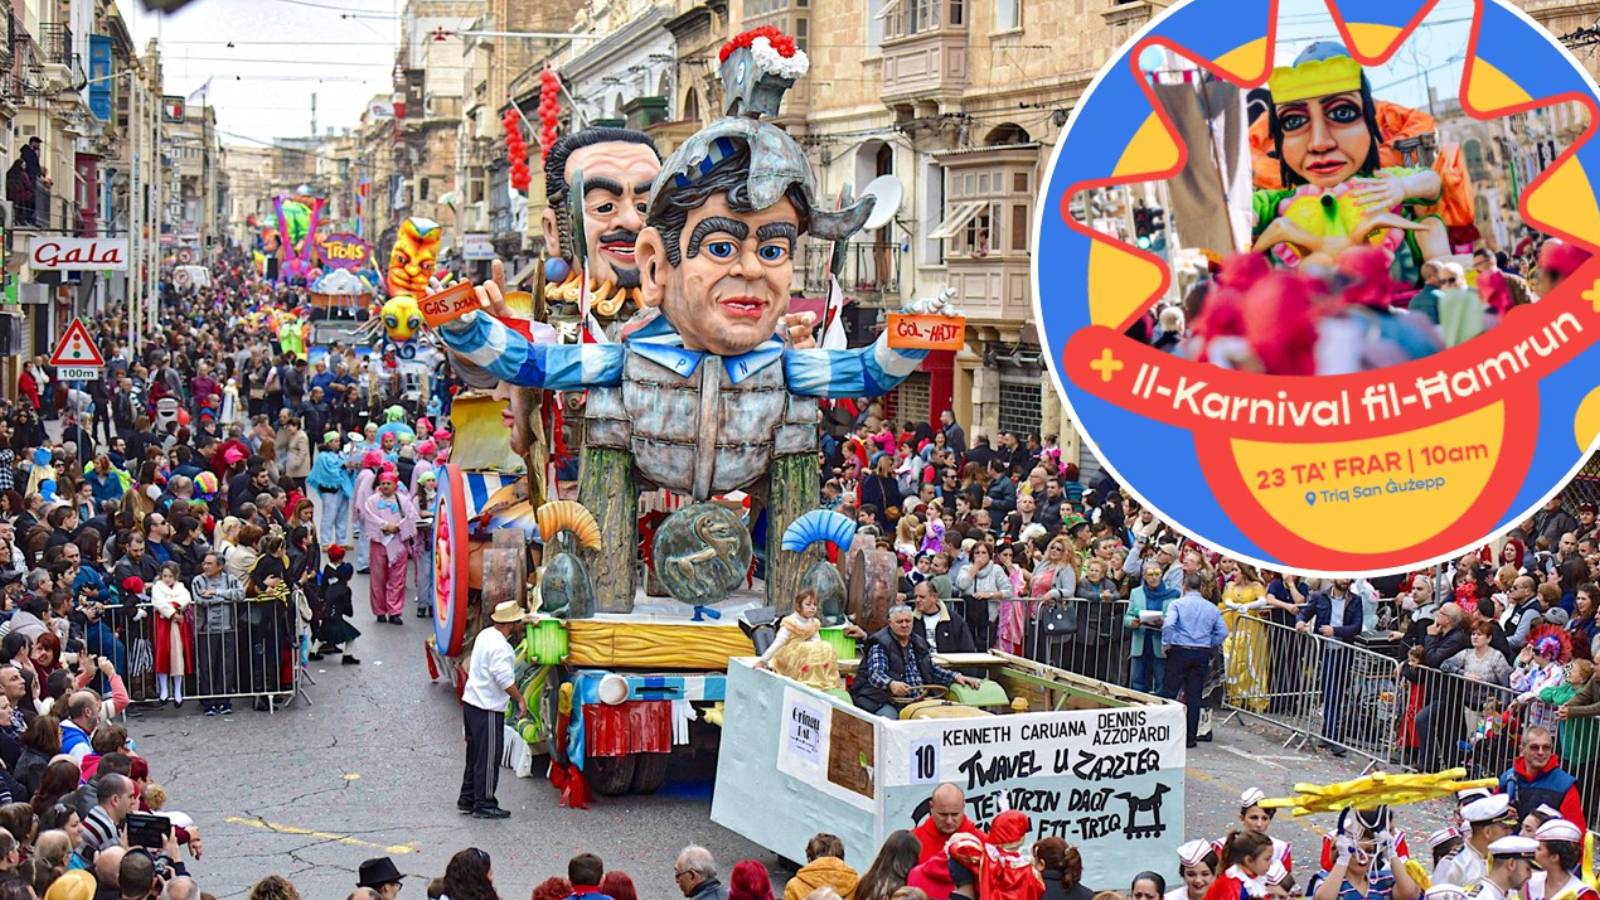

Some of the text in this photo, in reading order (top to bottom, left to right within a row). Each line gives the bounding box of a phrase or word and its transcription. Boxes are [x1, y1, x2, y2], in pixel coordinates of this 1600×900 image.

[35, 242, 122, 267] Gala
[424, 299, 449, 315] GAS
[62, 368, 95, 378] 100m
[1098, 711, 1147, 730] DENNIS
[943, 720, 1087, 747] KENNETH CARUANA
[1092, 724, 1170, 746] AZZOPARDI
[915, 744, 935, 779] 10
[958, 749, 1042, 790] TWAVEL
[1053, 748, 1069, 774] U
[1068, 788, 1115, 812] DAQT
